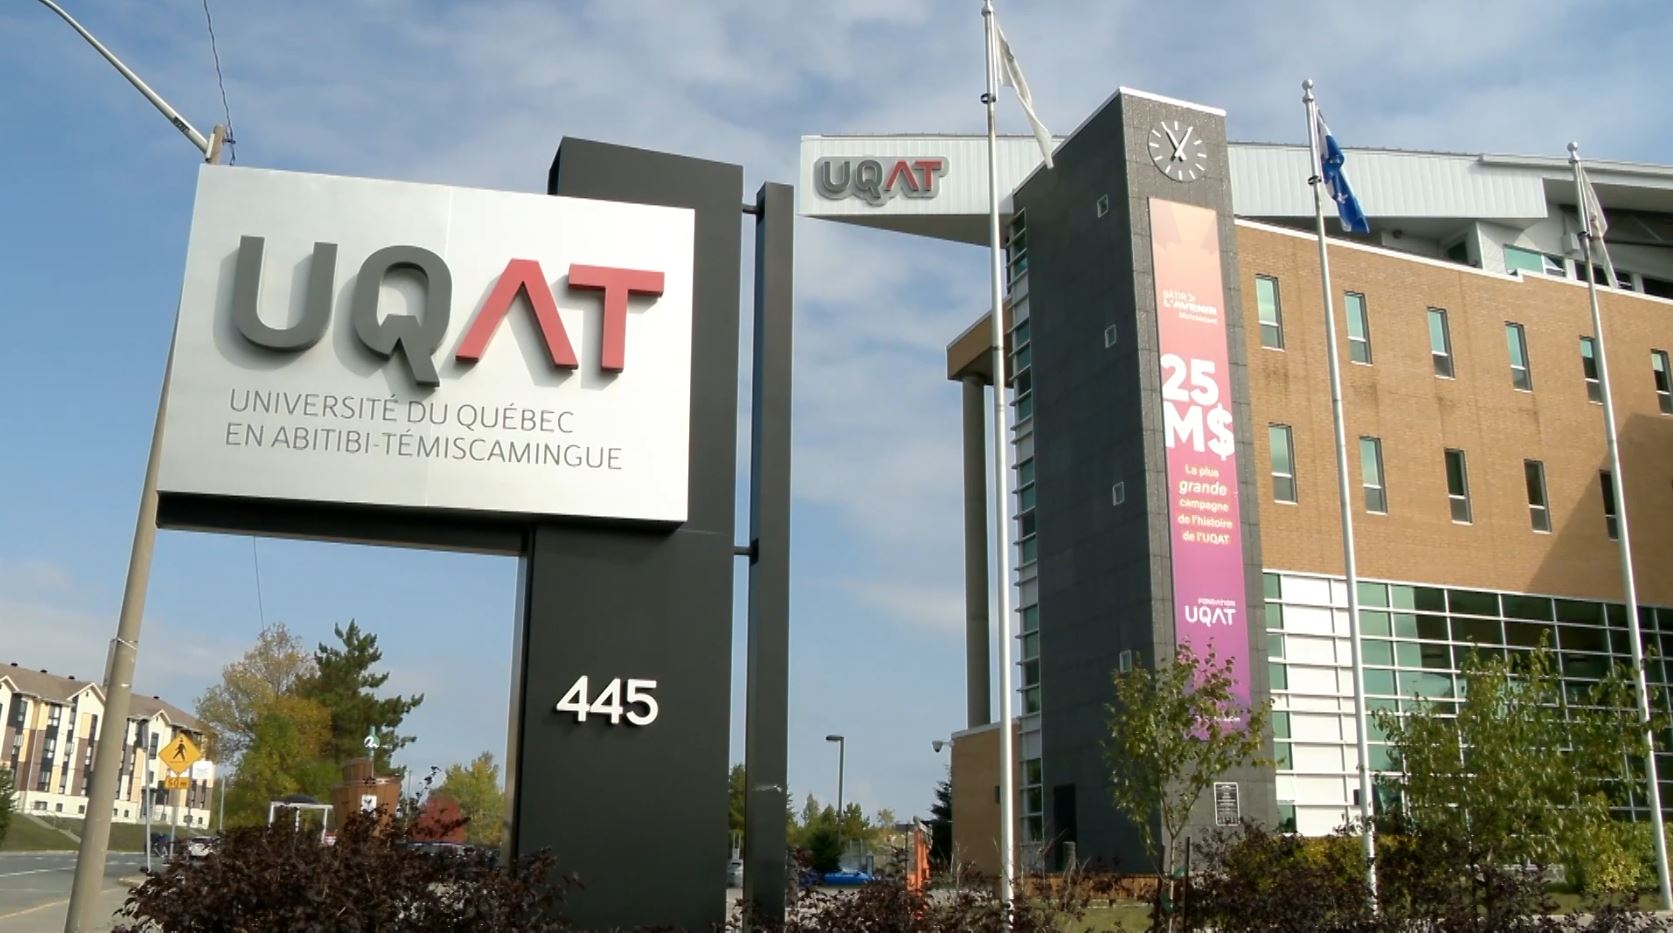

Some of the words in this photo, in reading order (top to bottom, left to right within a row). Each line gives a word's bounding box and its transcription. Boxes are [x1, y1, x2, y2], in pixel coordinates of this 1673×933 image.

[823, 159, 942, 199] UQAT
[232, 235, 666, 387] UQAT
[1163, 298, 1217, 316] L'AVENIR
[1160, 353, 1219, 406] 25
[230, 388, 398, 422] UNIVERSITÉ
[407, 400, 448, 425] DU
[457, 402, 574, 433] QUÉBEC
[225, 422, 264, 447] EN
[271, 426, 623, 470] ABITIBI-TÉMISCAMINGUE
[1163, 401, 1235, 461] M$
[1185, 464, 1197, 475] La
[1199, 467, 1219, 478] plus
[1179, 480, 1227, 496] grande
[1180, 498, 1230, 513] campagne
[1178, 514, 1190, 525] de
[1191, 515, 1233, 529] l'histoire
[1183, 531, 1195, 542] de
[1197, 532, 1230, 545] l'UQAT
[1184, 605, 1236, 627] UQAT
[556, 675, 659, 726] 445
